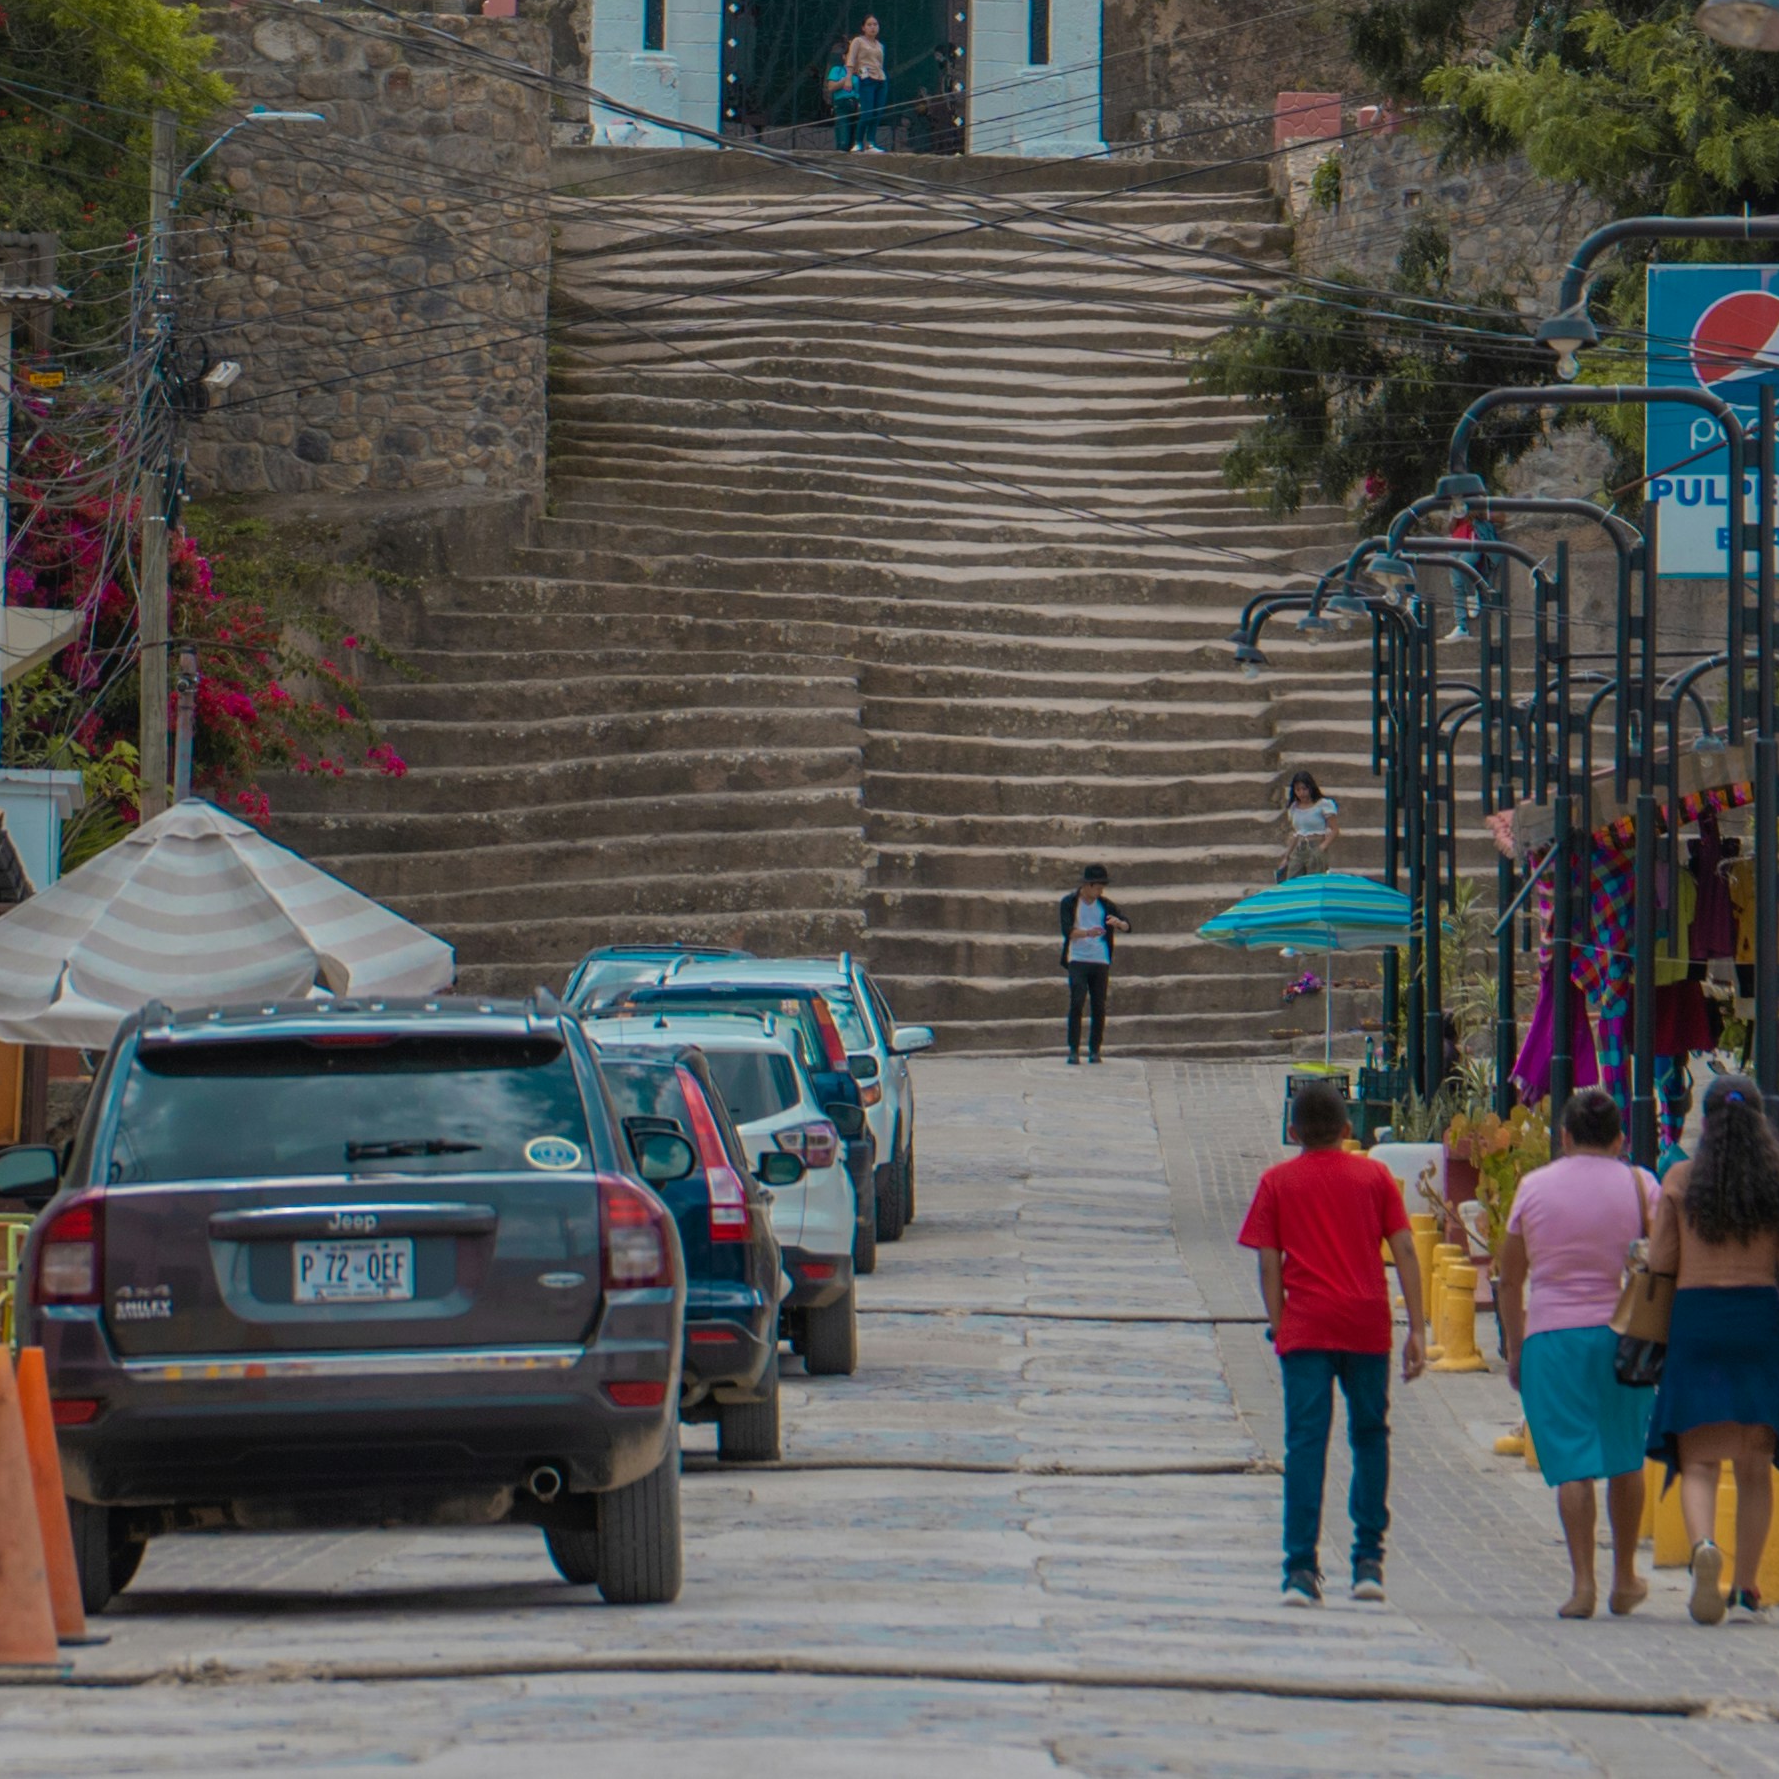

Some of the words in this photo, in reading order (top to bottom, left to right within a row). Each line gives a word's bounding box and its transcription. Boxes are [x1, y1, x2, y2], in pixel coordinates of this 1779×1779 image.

[328, 1213, 377, 1232] Jeep
[301, 1254, 313, 1283] P
[326, 1253, 350, 1282] 72
